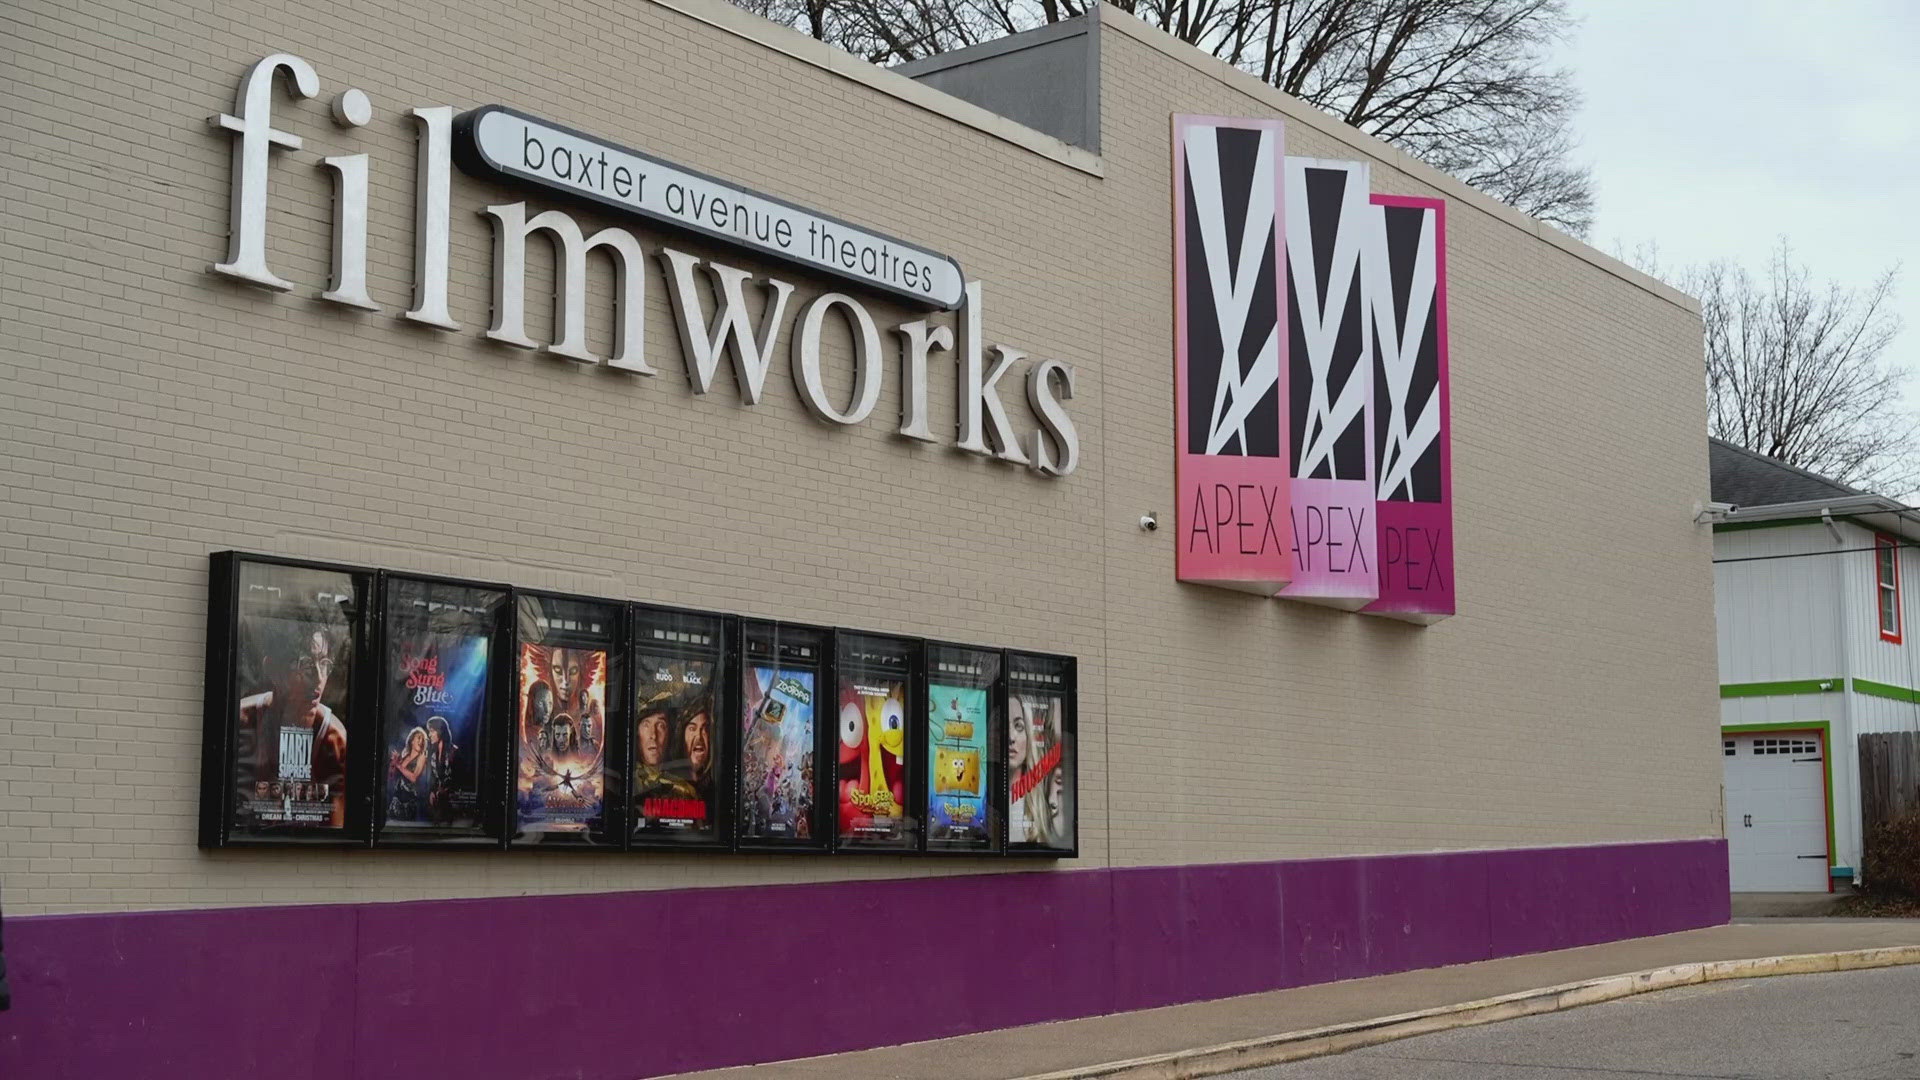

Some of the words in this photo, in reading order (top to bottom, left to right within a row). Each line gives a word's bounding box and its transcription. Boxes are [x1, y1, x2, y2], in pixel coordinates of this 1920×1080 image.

[523, 127, 647, 202] baxter
[665, 183, 792, 248] avenue
[808, 220, 932, 293] theatres
[205, 53, 1079, 478] filmworks
[1189, 483, 1282, 556] APEX
[1378, 526, 1445, 592] PEX
[413, 685, 454, 705] Blue
[279, 733, 314, 766] MARTY
